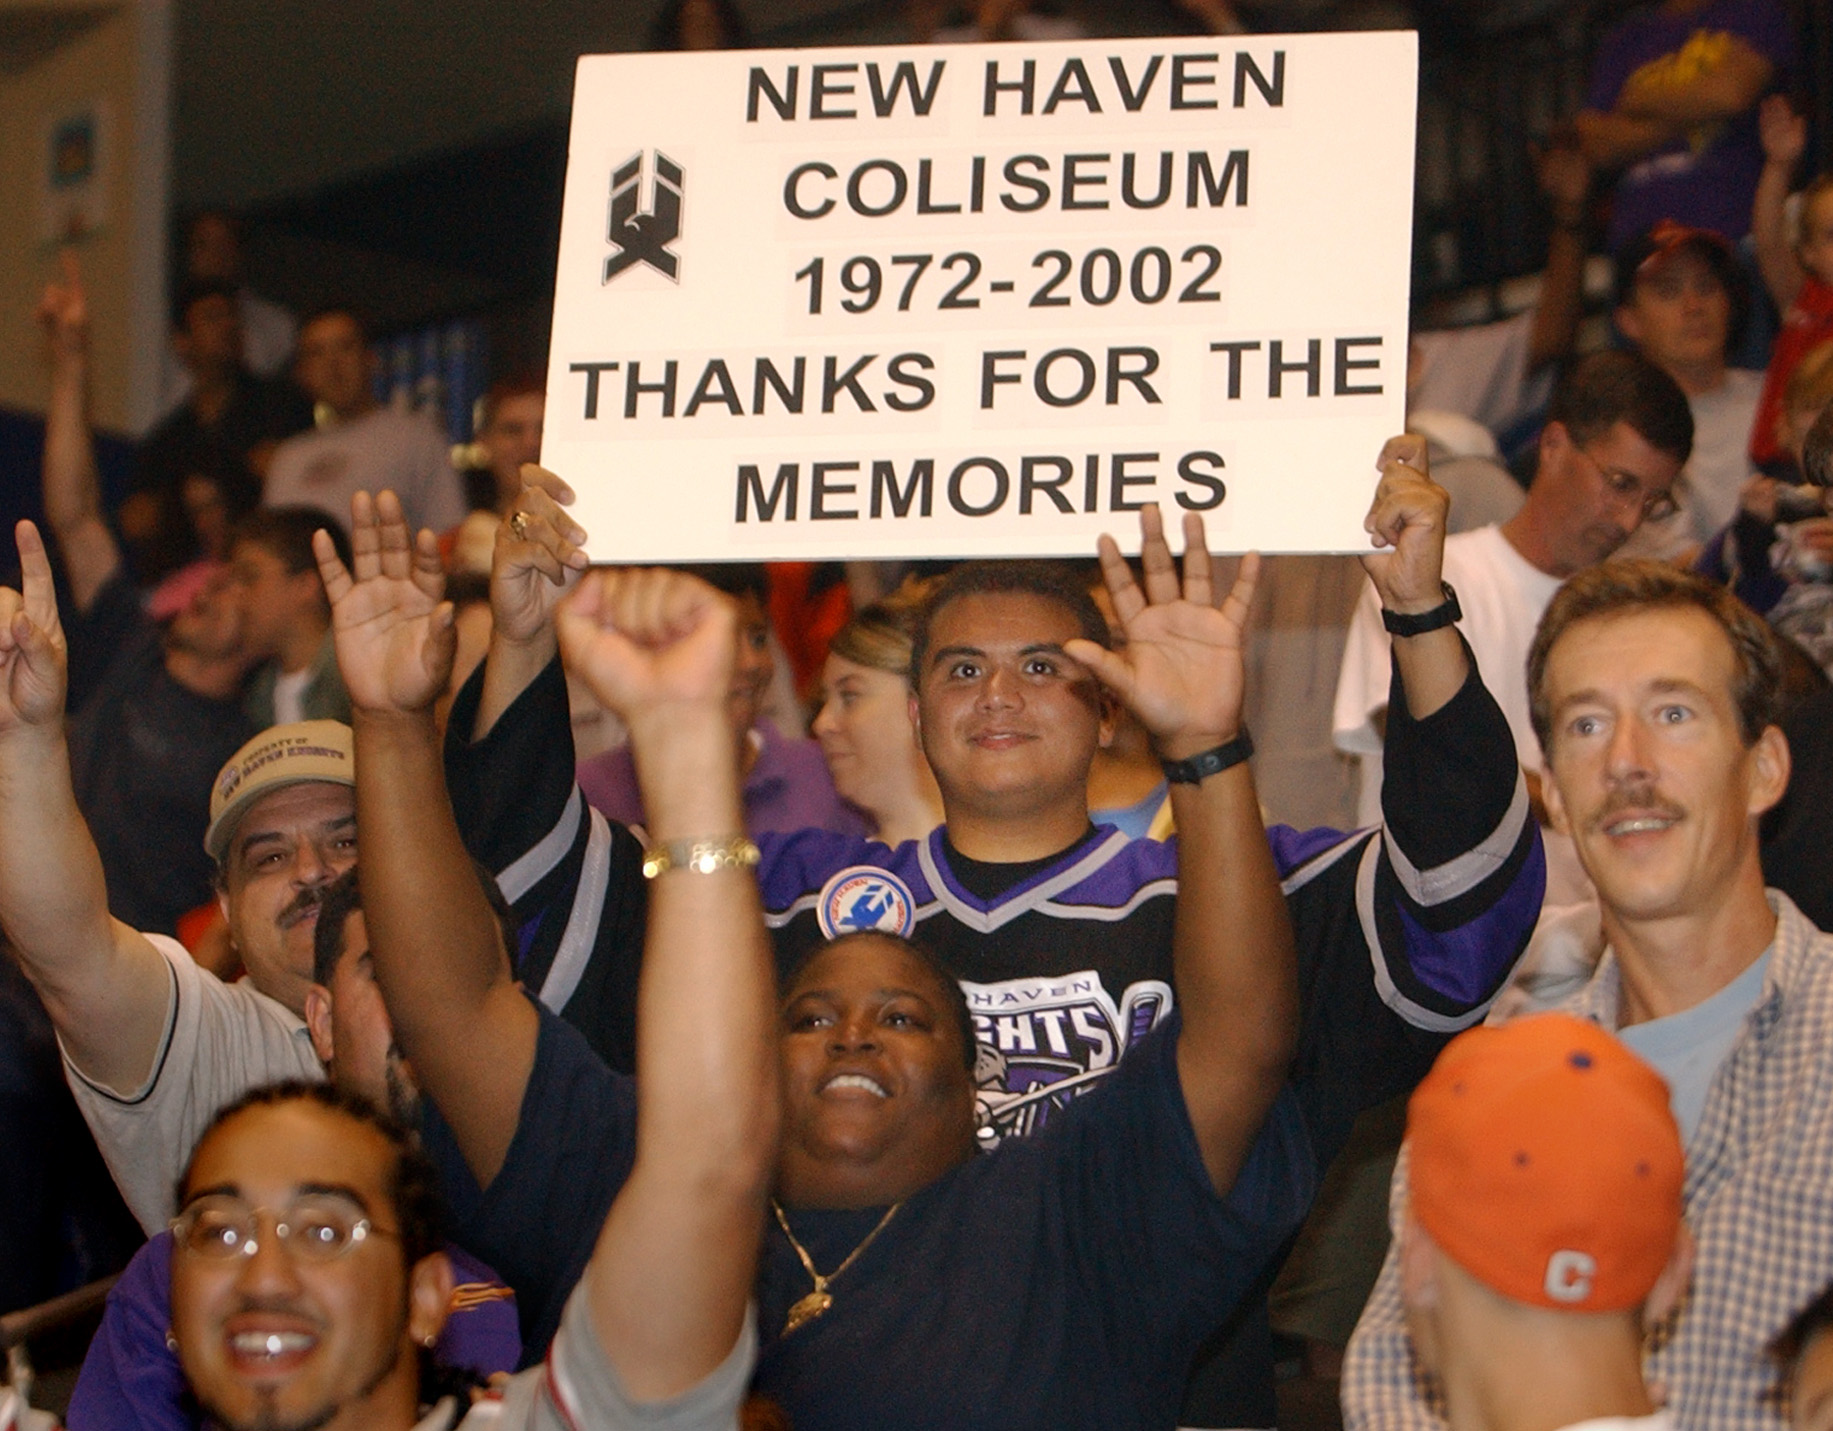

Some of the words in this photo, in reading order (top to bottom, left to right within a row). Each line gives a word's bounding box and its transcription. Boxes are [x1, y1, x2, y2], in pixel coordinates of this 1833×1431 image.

[747, 61, 945, 122] NEW
[983, 51, 1287, 116] HAVEN
[783, 150, 1250, 220] COLISEUM
[796, 245, 1223, 315] 1972-2002
[569, 355, 936, 420] THANKS
[980, 347, 1162, 410] FOR
[1210, 336, 1384, 399] THE
[735, 451, 1227, 524] MEMORIES
[973, 980, 1091, 1006] HAVEN
[1544, 1249, 1597, 1302] C
